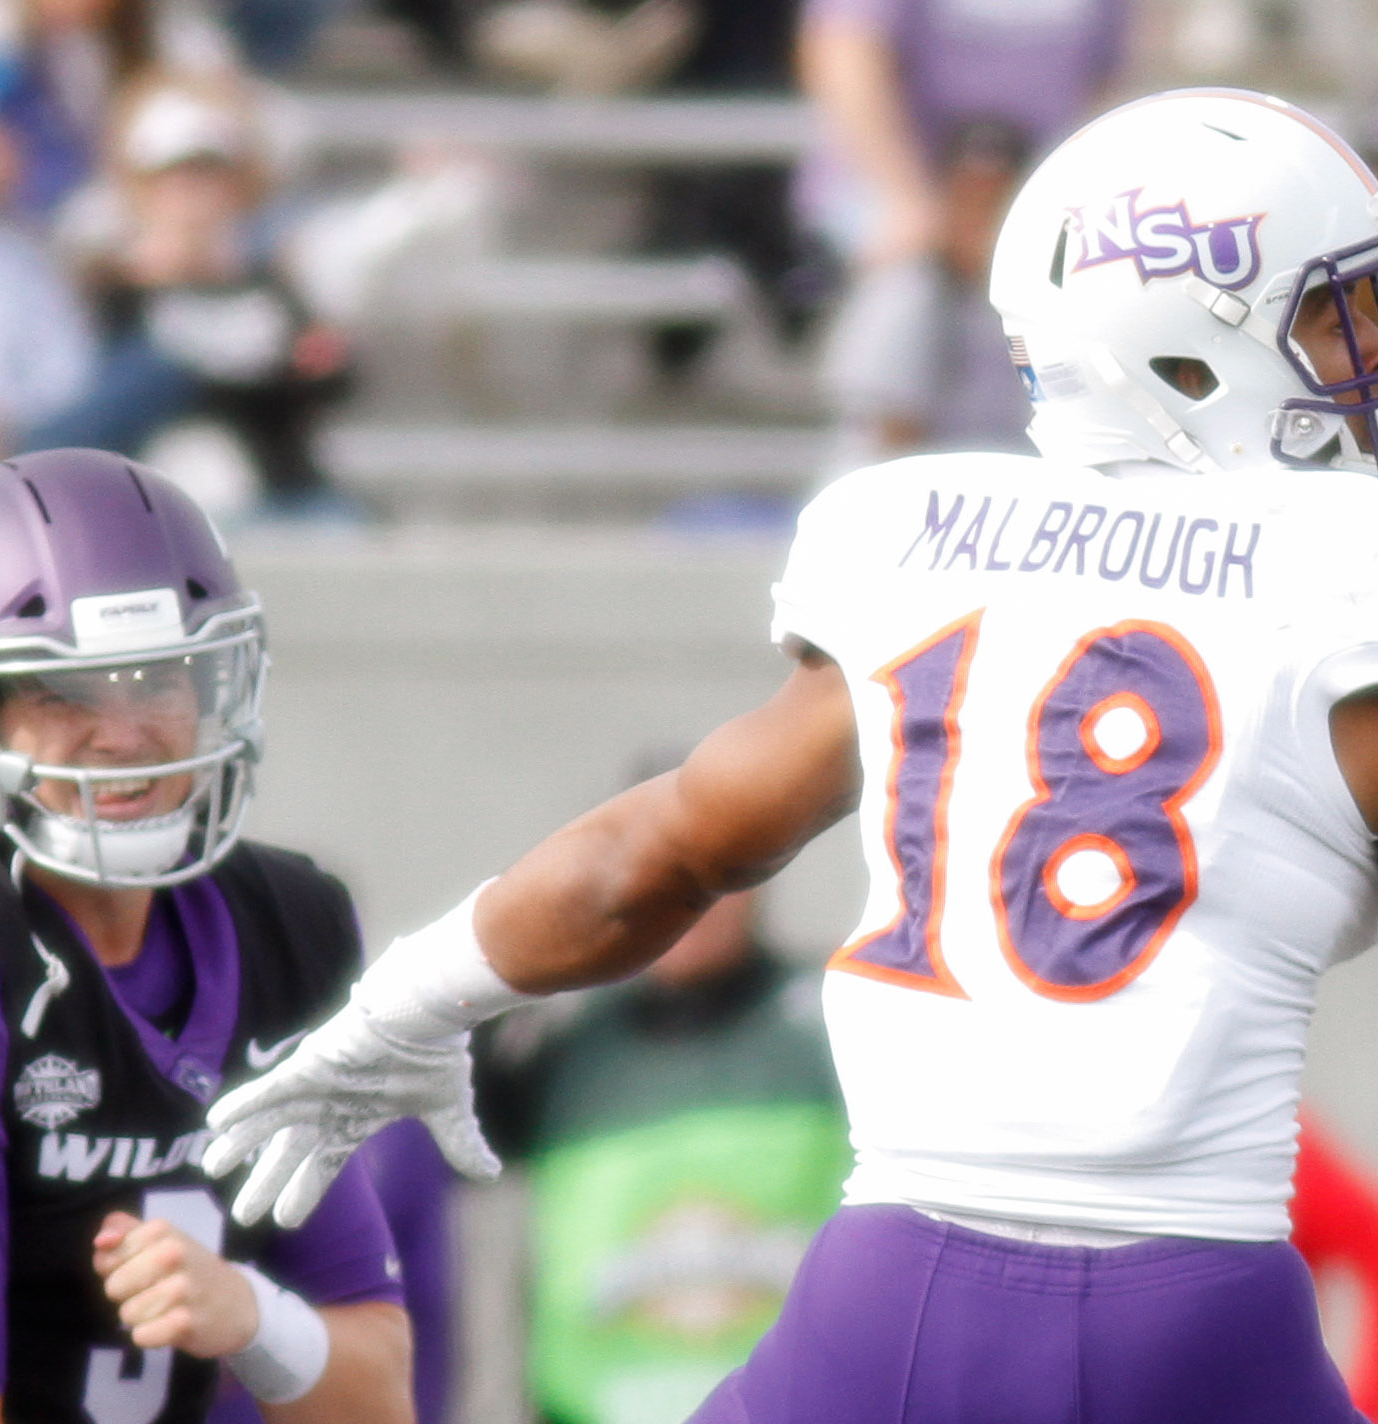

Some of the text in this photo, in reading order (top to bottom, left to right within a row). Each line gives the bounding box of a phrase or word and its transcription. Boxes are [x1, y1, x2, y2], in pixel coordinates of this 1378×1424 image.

[1064, 187, 1269, 292] NSU
[898, 489, 1261, 599] MALBROUGH
[825, 606, 1224, 1004] 18
